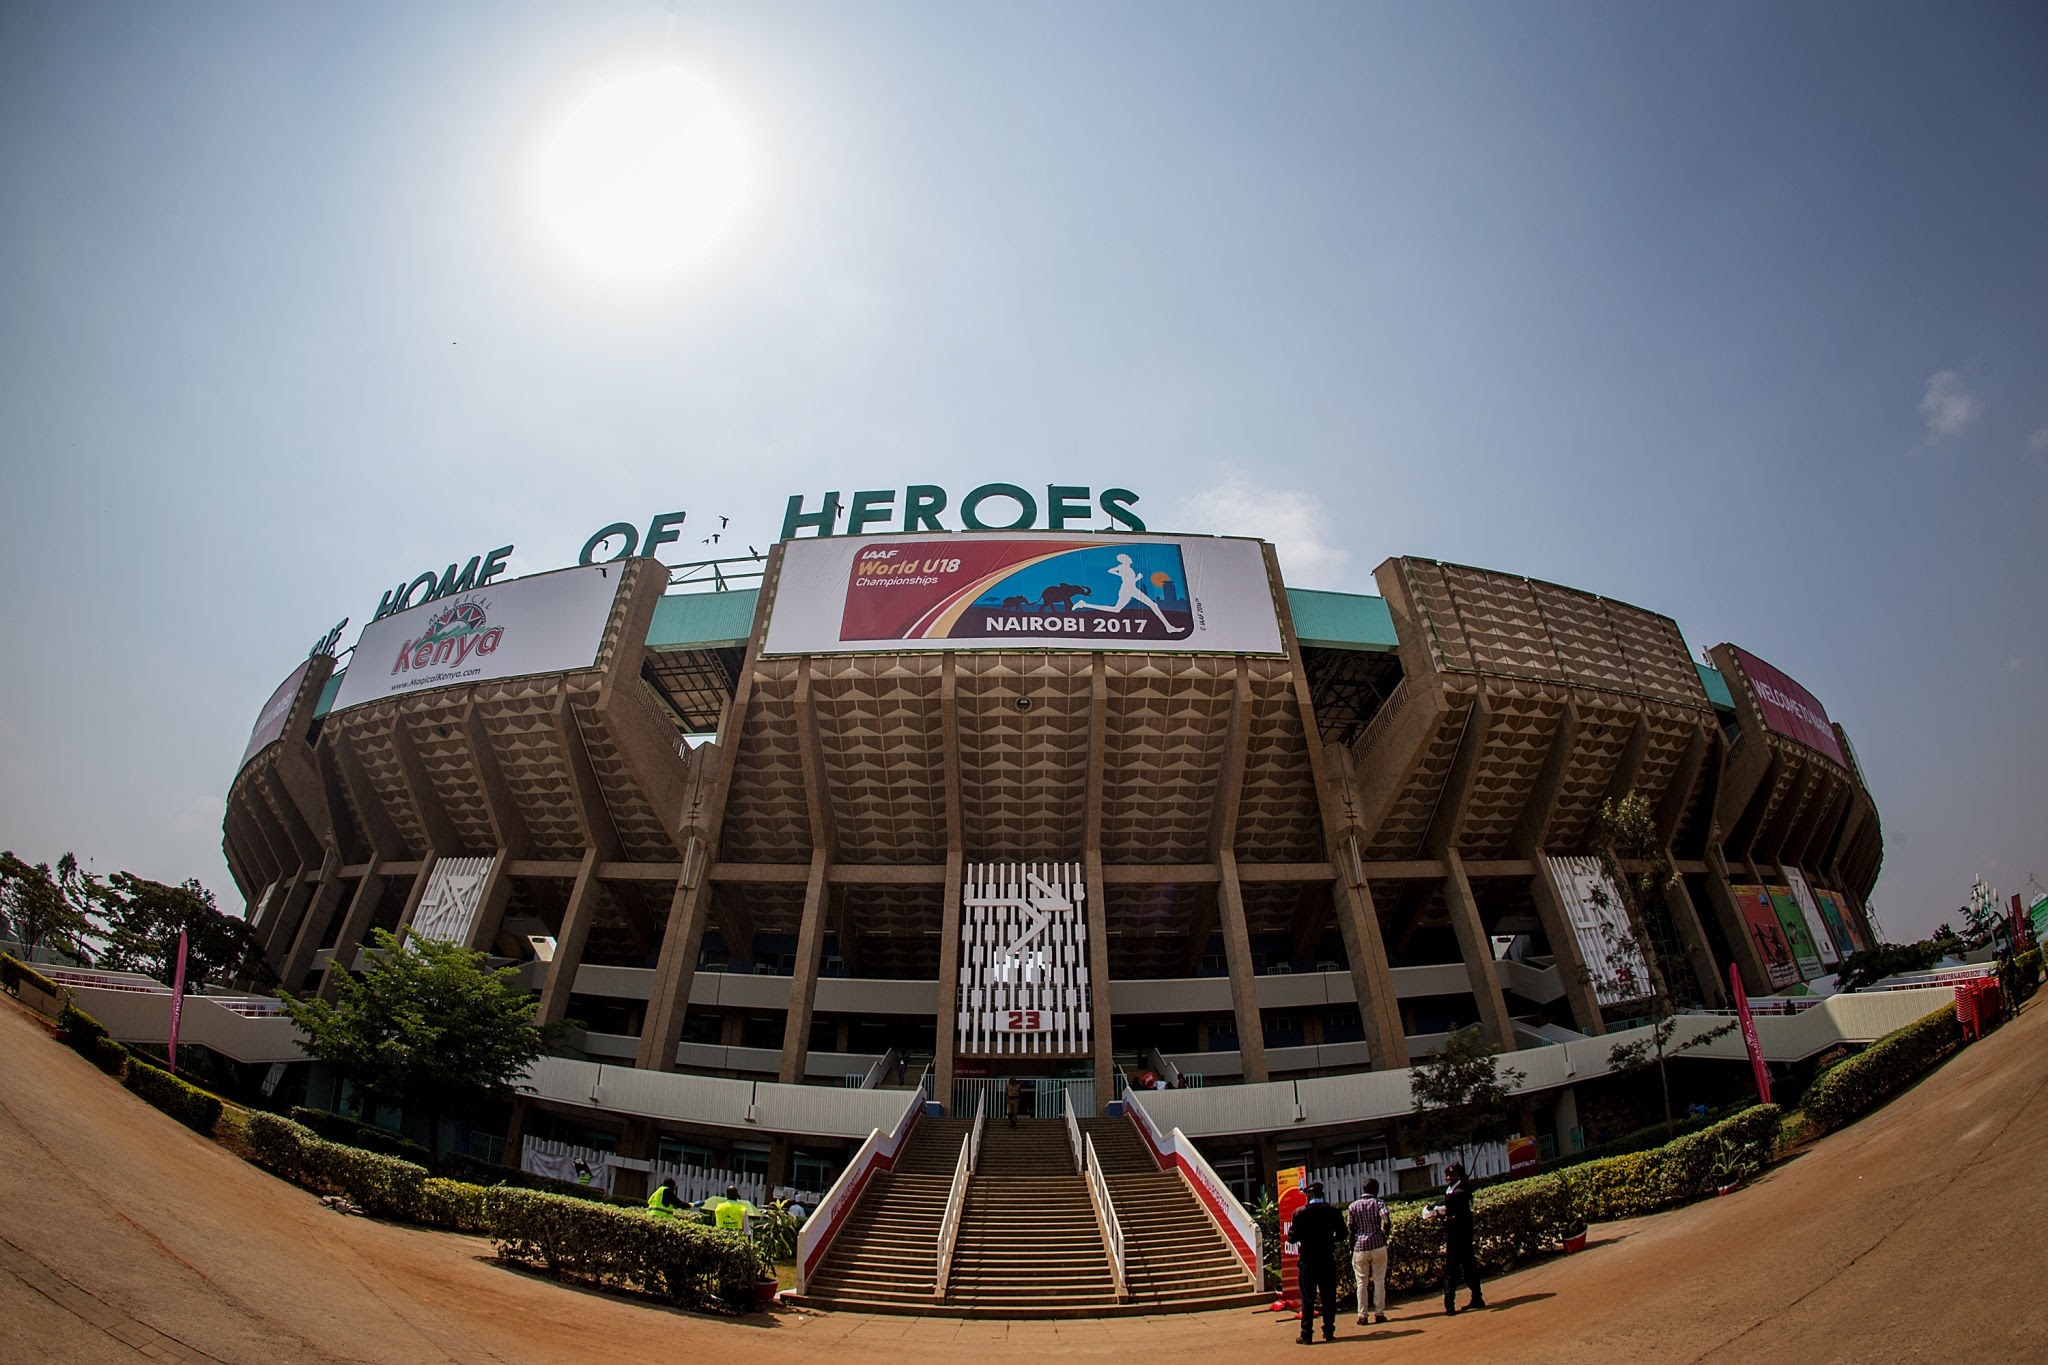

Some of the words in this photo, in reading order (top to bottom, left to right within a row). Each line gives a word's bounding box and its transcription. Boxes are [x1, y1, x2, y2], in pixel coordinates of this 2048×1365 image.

[372, 544, 514, 622] HOME
[578, 511, 686, 566] OF
[780, 483, 1146, 542] HEROES
[862, 549, 899, 560] IAAF
[858, 559, 919, 576] World
[922, 558, 961, 573] U18
[856, 575, 938, 588] Championships
[986, 617, 1085, 632] NAIROBI
[1093, 618, 1148, 633] 2017
[390, 626, 505, 676] Kenya
[391, 668, 482, 691] www.MagicalKenya.com
[1750, 677, 1803, 719] WELCOME
[1008, 1011, 1040, 1029] 23
